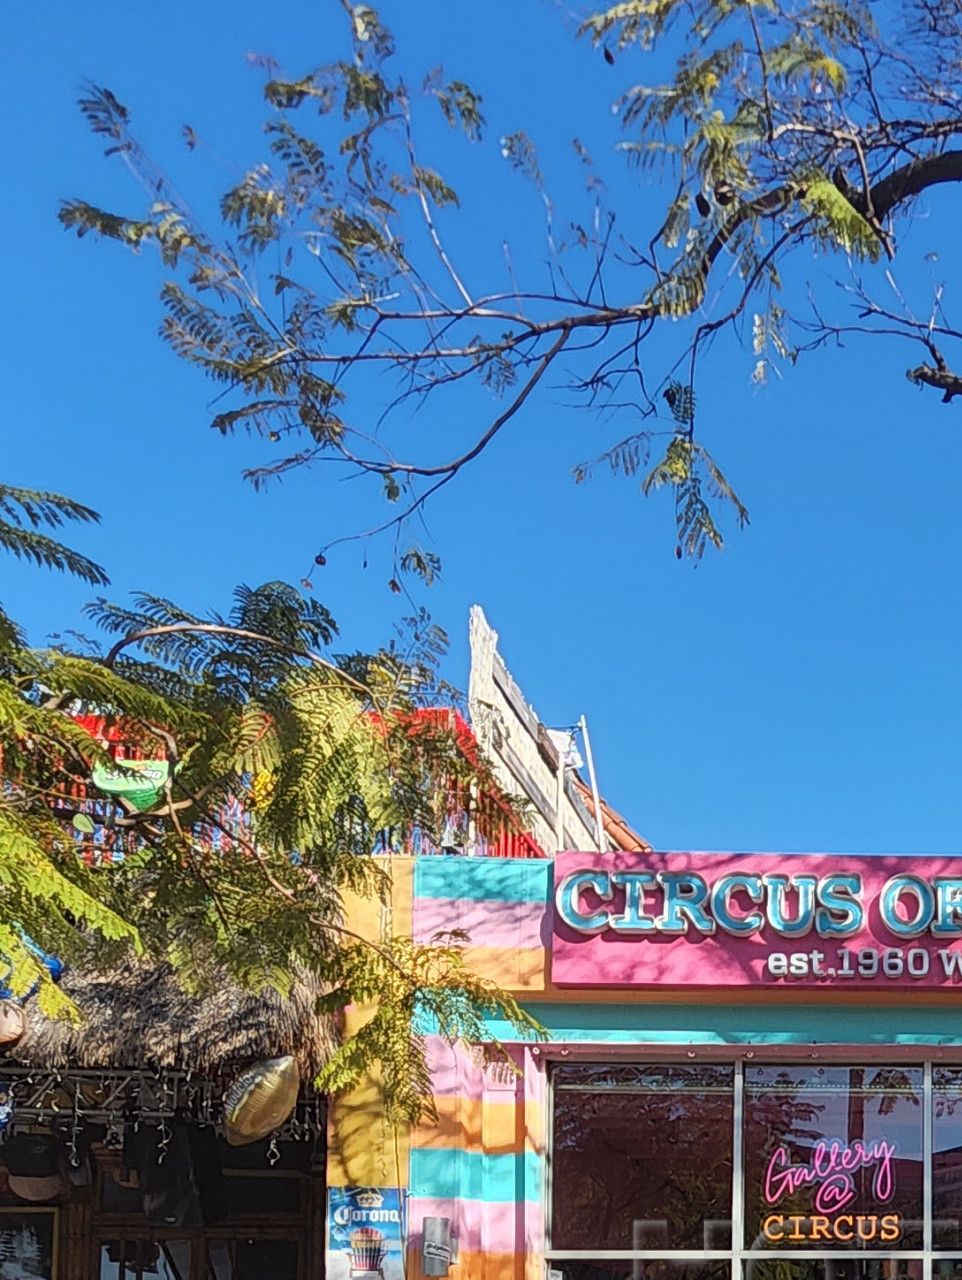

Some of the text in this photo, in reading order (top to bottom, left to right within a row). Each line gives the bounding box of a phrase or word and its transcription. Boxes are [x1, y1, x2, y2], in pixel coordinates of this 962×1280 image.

[559, 870, 863, 936] CIRCUS
[765, 1140, 895, 1203] Gallery
[816, 1174, 854, 1214] @
[334, 1206, 400, 1223] Corona
[764, 1215, 900, 1240] CIRCUS
